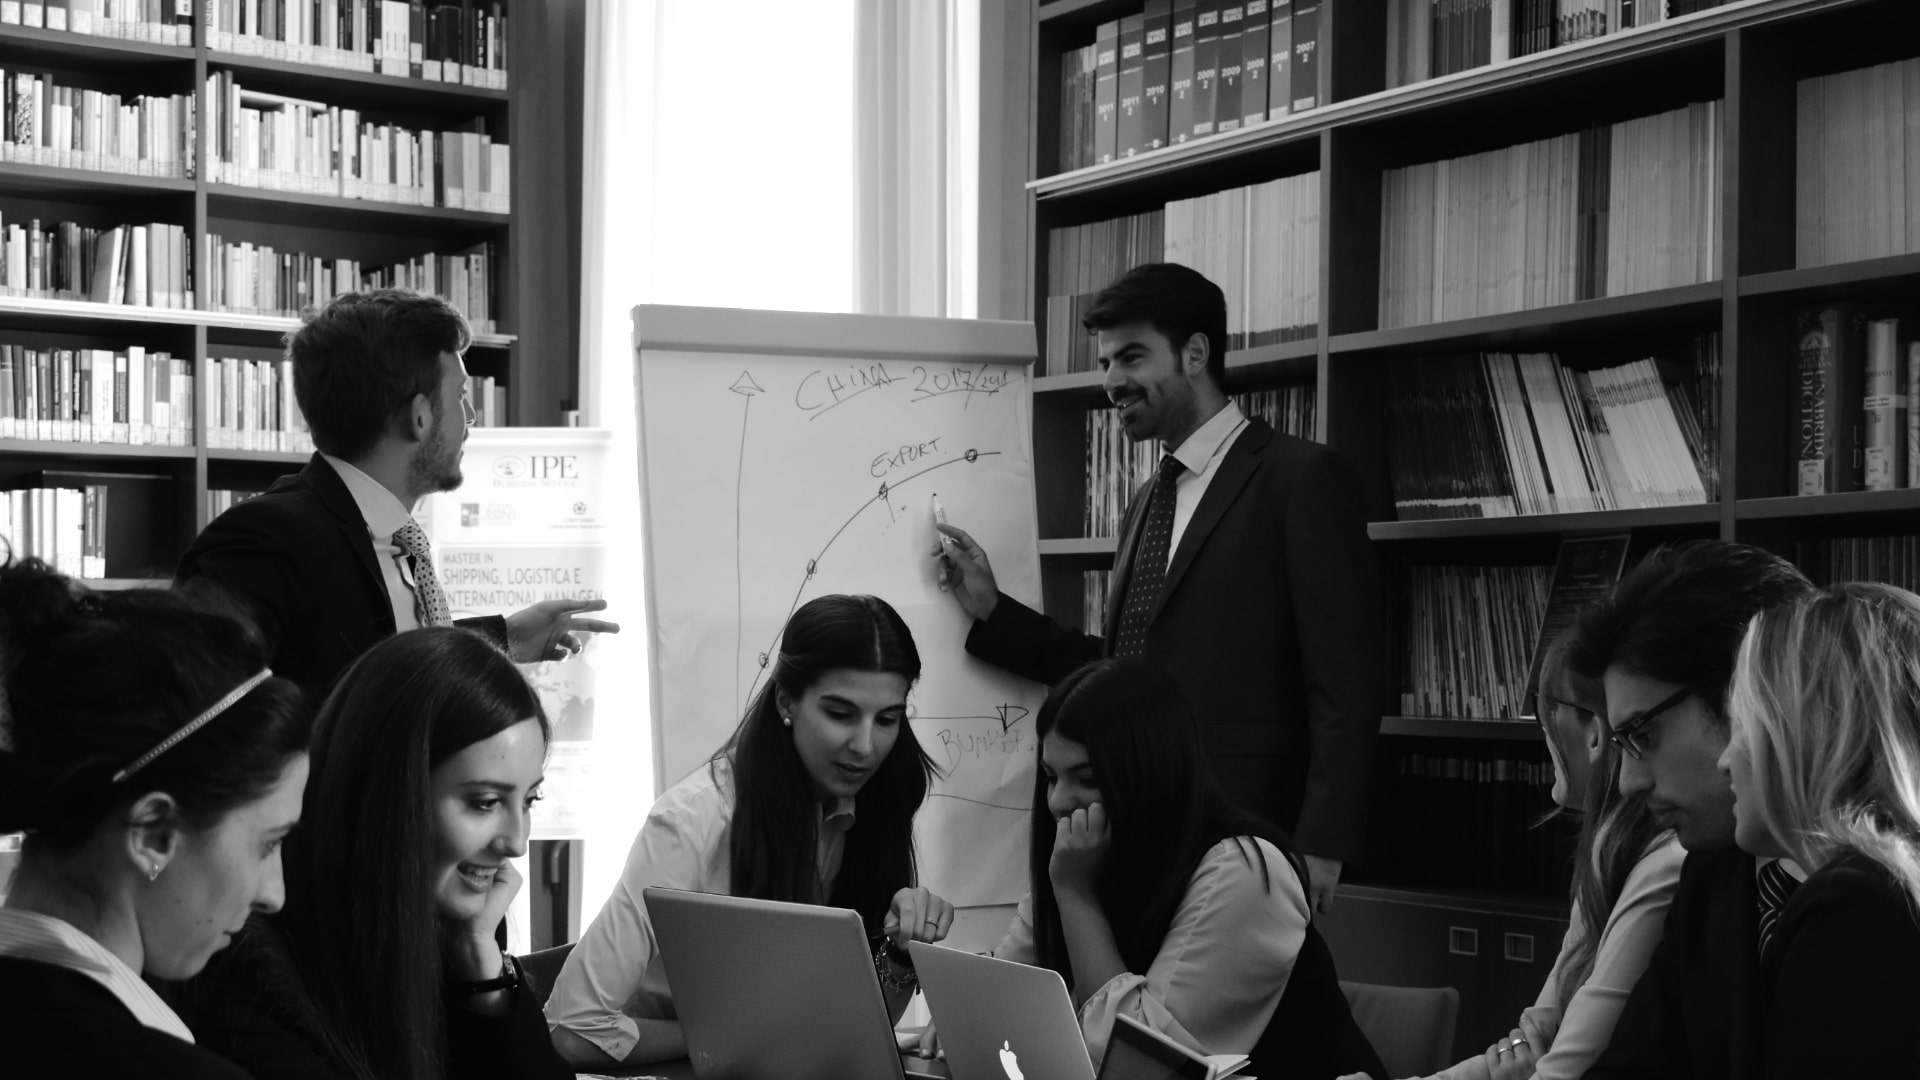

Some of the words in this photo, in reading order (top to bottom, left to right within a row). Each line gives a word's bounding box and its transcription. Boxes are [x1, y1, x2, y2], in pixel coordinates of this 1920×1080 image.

[1296, 41, 1315, 54] 2007
[1303, 53, 1308, 63] 2
[1221, 65, 1241, 78] 2009
[1277, 63, 1282, 72] 1
[1197, 69, 1215, 81] 2009
[1252, 70, 1258, 79] 2
[1202, 80, 1208, 89] 2
[1228, 77, 1233, 86] 1
[1146, 85, 1165, 97] 2010
[1179, 90, 1185, 99] 2
[1122, 95, 1139, 108] 2011
[1152, 96, 1157, 105] 1
[1127, 107, 1133, 116] 2
[1103, 114, 1108, 123] 1
[530, 455, 578, 479] IPE
[443, 552, 481, 564] MASTER
[483, 552, 494, 564] IN
[443, 567, 503, 587] SHIPPING,
[507, 567, 571, 585] LOGISTICA
[574, 567, 581, 585] E
